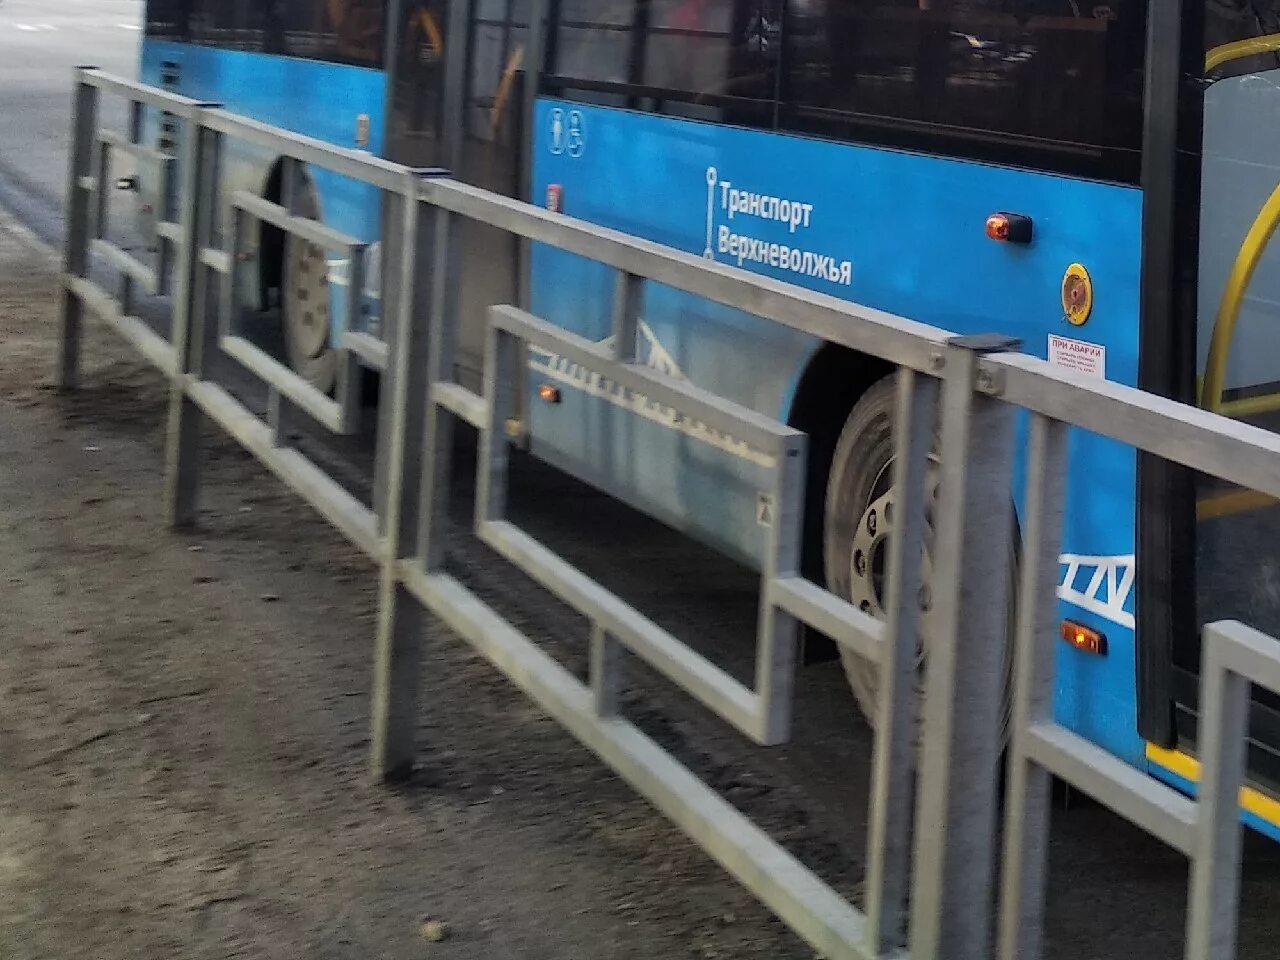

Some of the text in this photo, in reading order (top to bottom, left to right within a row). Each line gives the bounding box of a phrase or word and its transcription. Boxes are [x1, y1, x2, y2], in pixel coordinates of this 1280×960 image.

[719, 180, 813, 233] Транспорт
[717, 224, 852, 286] Верхневолжья
[1052, 339, 1101, 357] ПРИ АВАРИИ
